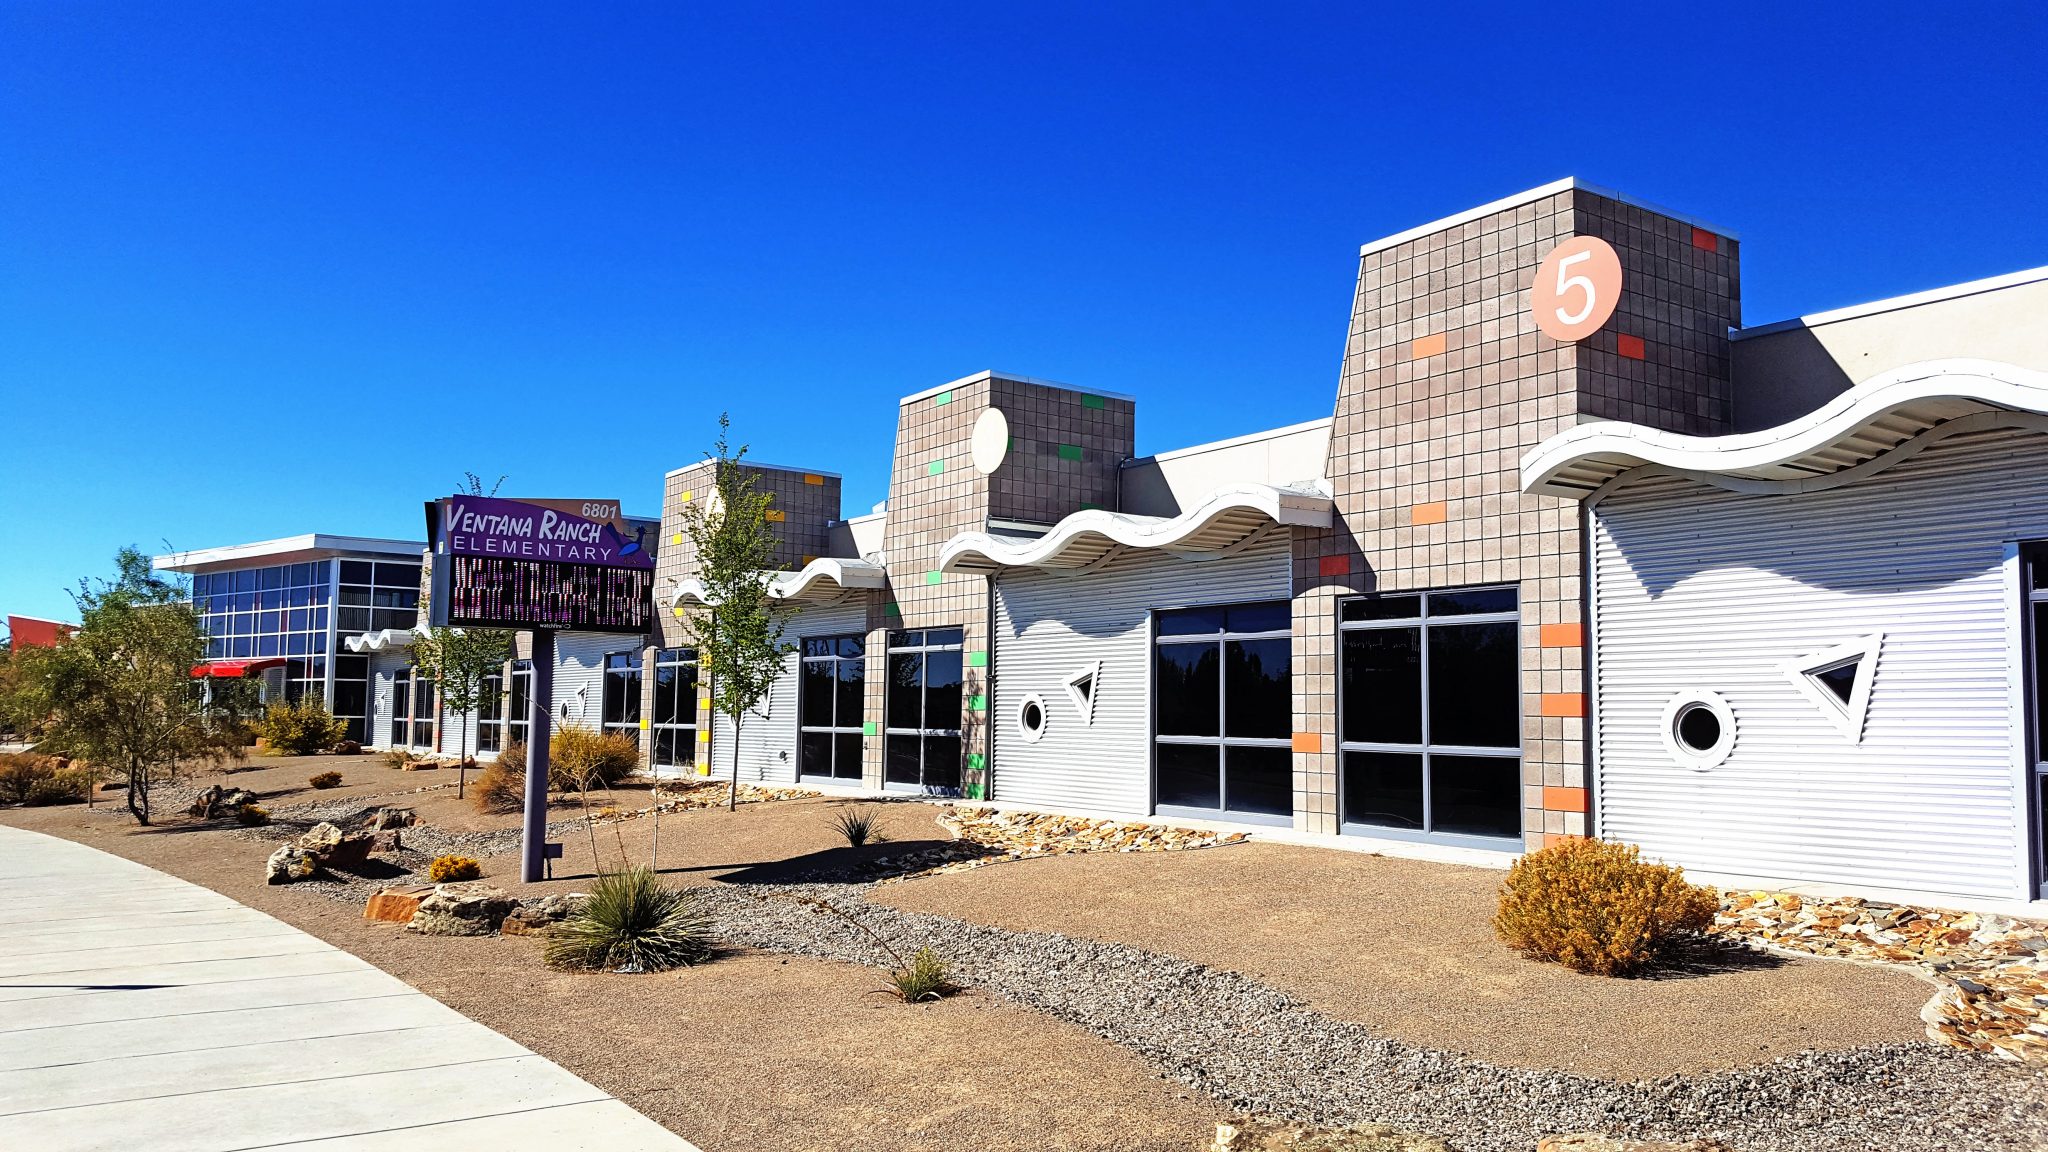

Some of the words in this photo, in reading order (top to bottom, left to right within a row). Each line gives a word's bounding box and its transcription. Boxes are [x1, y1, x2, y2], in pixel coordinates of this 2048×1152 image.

[1555, 250, 1596, 325] 5
[447, 504, 532, 537] VENTANA
[539, 510, 601, 544] RANCH
[581, 502, 617, 520] 6801
[453, 536, 612, 561] ELEMENTARY
